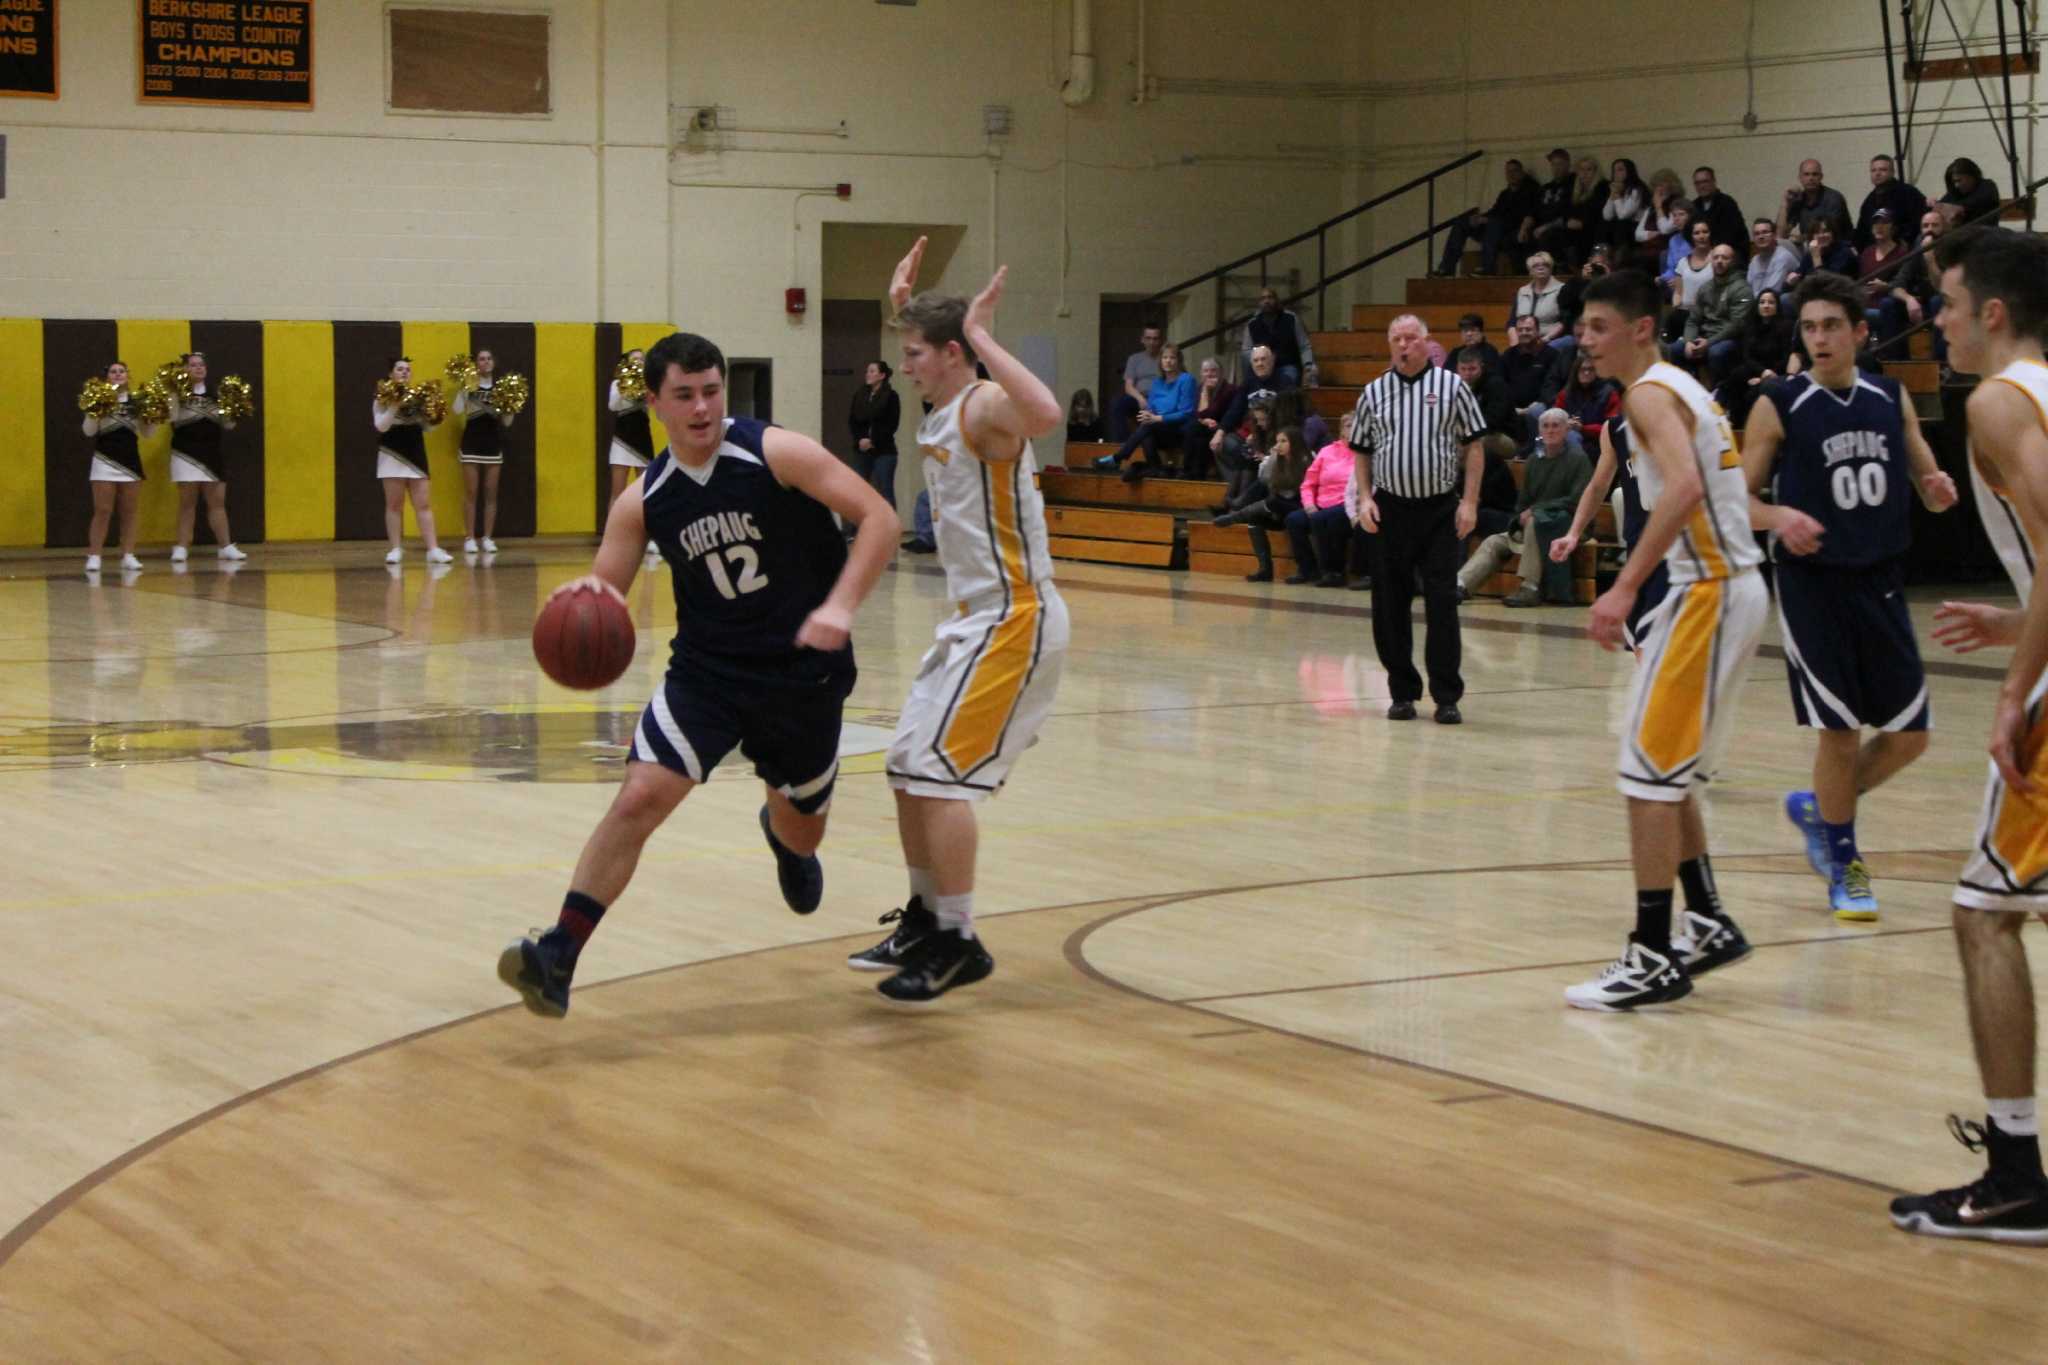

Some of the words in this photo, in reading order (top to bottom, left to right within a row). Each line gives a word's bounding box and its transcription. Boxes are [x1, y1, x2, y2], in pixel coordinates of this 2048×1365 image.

[149, 0, 236, 21] BERKSHIRE
[241, 5, 304, 24] LEAGUE
[150, 20, 186, 39] BOYS
[191, 23, 235, 42] CROSS
[241, 26, 301, 45] COUNTRY
[0, 36, 38, 55] NS
[158, 43, 295, 66] CHAMPIONS
[1831, 461, 1888, 510] 00
[679, 511, 763, 561] SHEPAUG
[704, 544, 769, 600] 12
